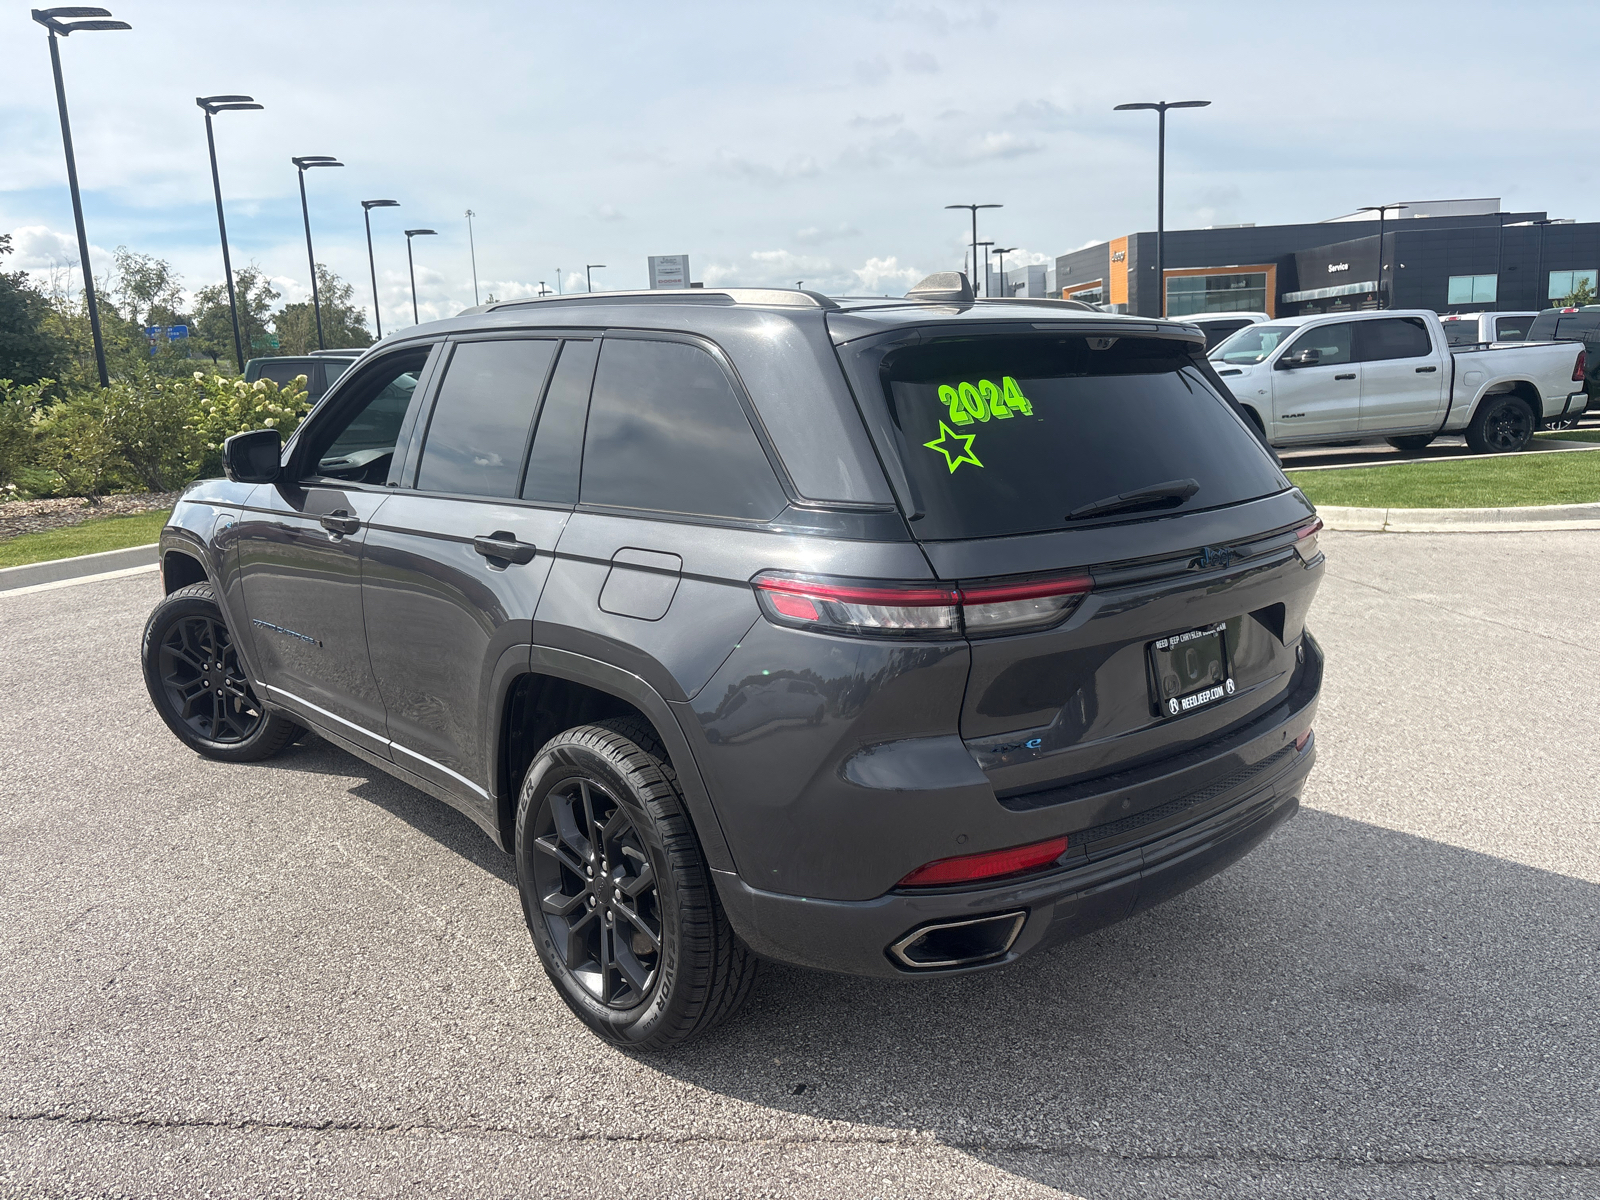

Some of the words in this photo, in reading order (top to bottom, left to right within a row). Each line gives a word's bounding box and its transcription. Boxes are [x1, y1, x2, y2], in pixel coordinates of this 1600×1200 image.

[1328, 262, 1349, 273] Service
[938, 376, 1034, 426] 2024
[1156, 639, 1169, 650] REED
[1169, 635, 1180, 645] JEEP
[1180, 630, 1202, 643] CHRYSLER
[1181, 685, 1224, 710] REEDJEEP.COM
[642, 1012, 659, 1031] PLUS
